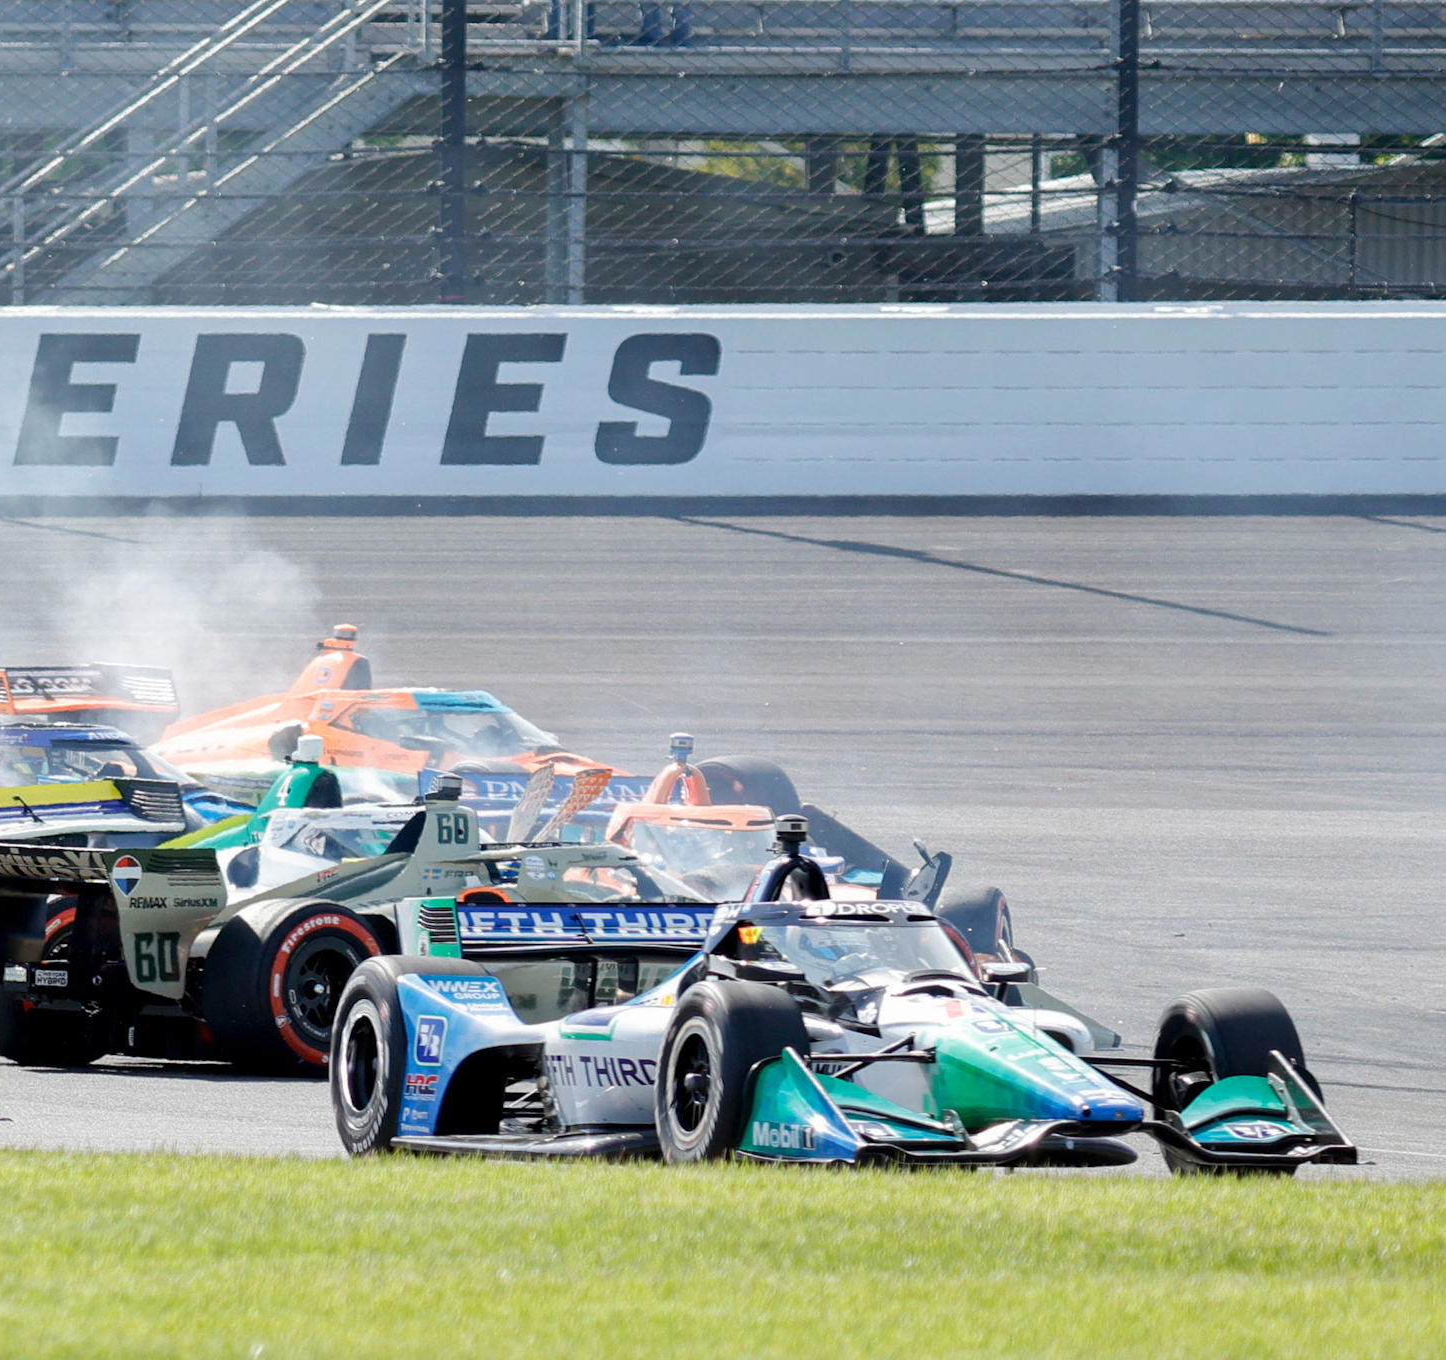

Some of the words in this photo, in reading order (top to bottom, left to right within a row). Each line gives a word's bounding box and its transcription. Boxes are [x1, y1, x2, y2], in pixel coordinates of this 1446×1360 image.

[276, 775, 292, 806] 4
[435, 813, 469, 845] 60
[129, 897, 167, 909] REMAX
[173, 897, 218, 908] SiriusXM
[281, 914, 341, 955] Firestone
[134, 931, 181, 984] 60
[453, 992, 501, 1001] GROUP
[579, 1055, 659, 1086] THIRD
[752, 1120, 801, 1149] Mobil
